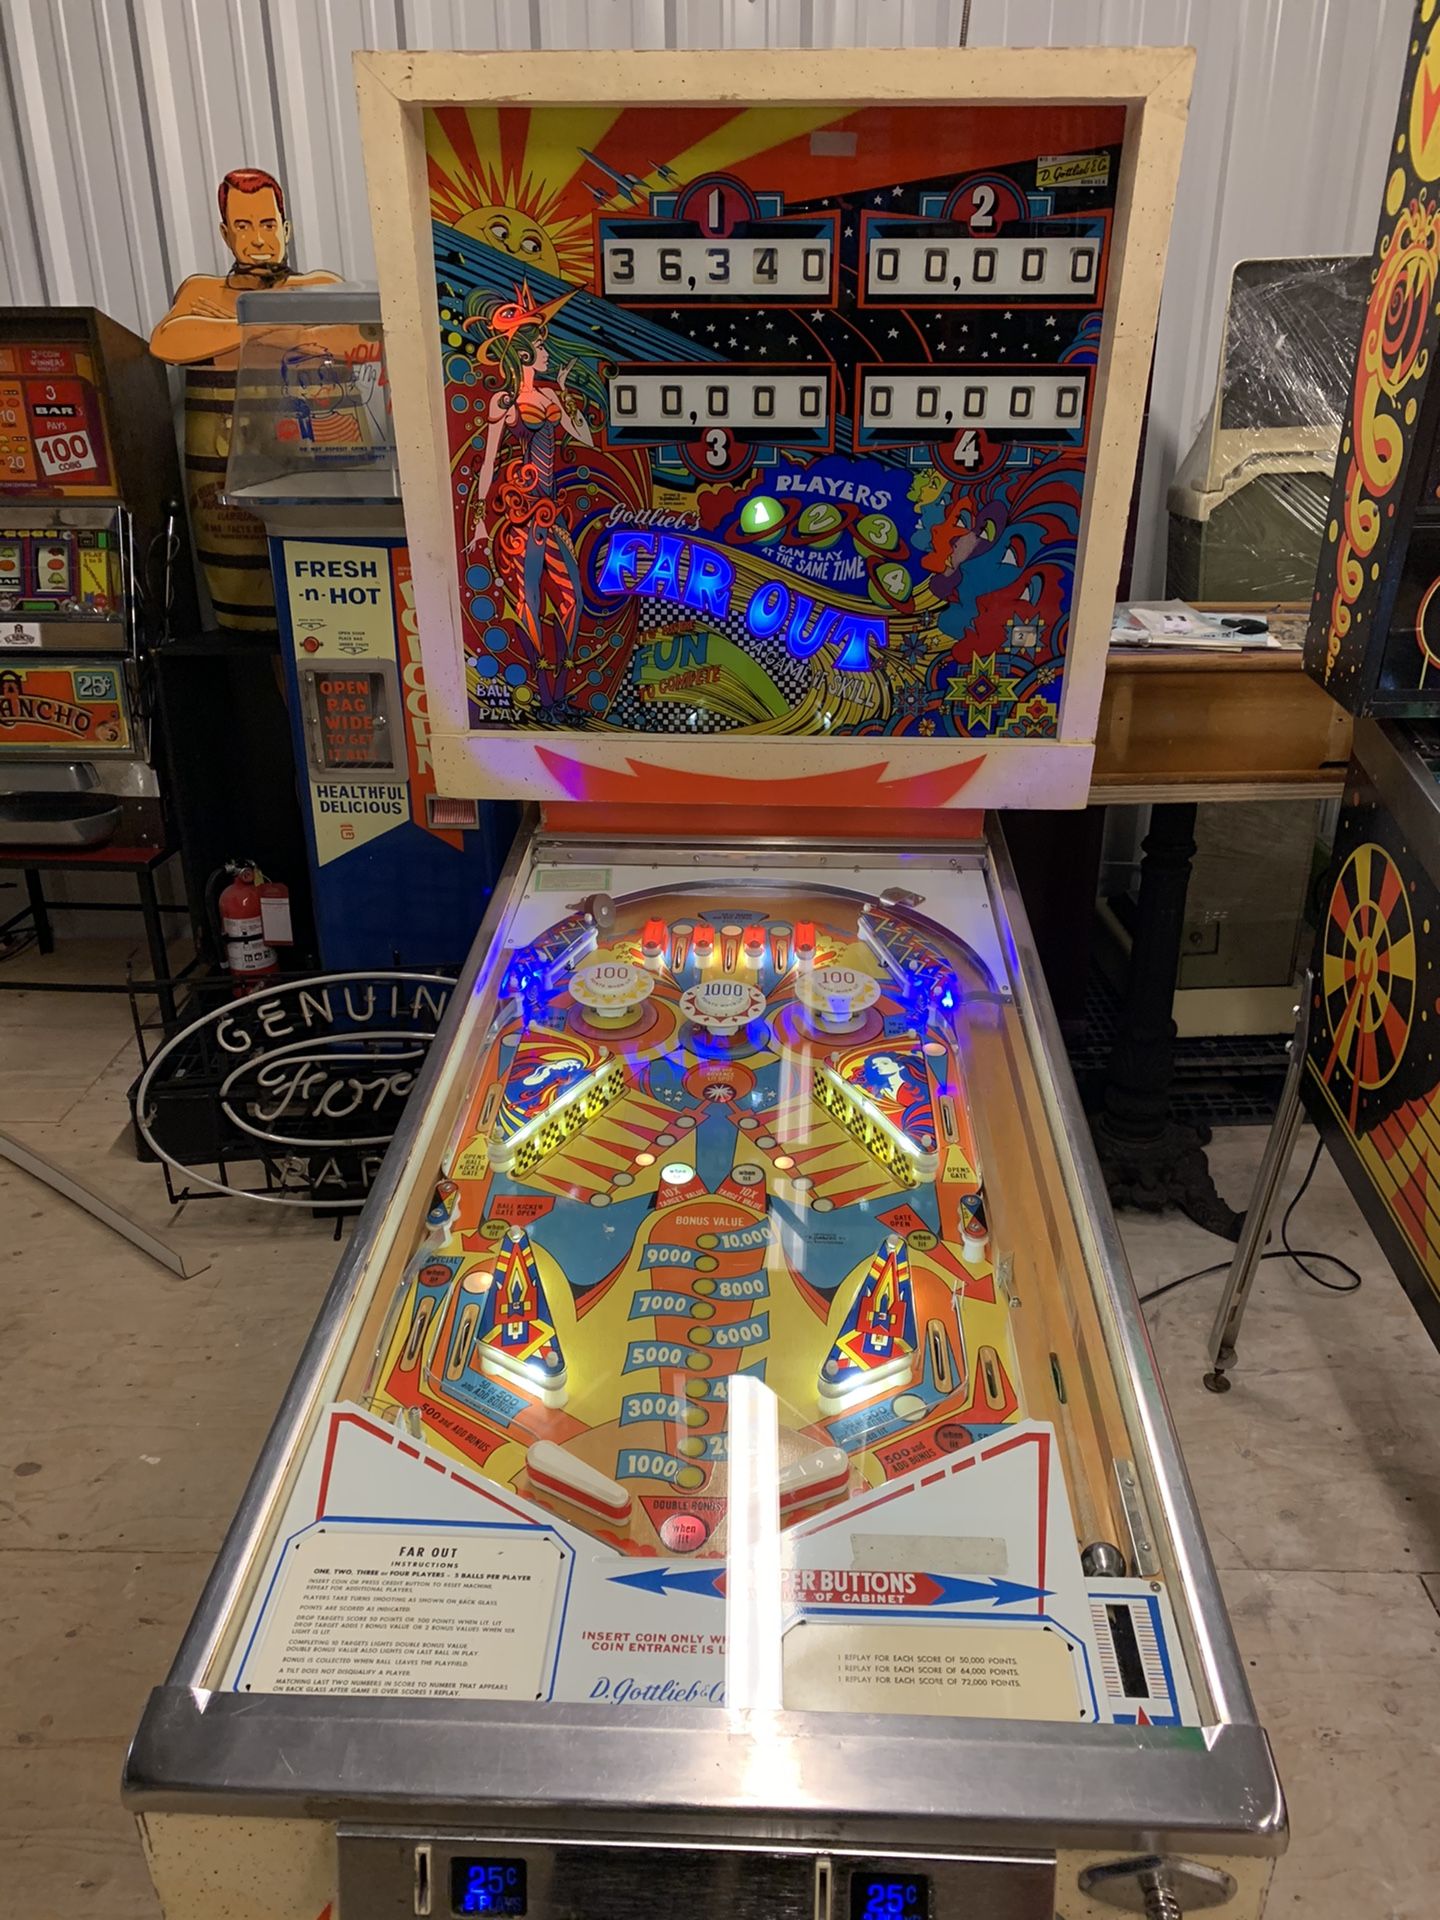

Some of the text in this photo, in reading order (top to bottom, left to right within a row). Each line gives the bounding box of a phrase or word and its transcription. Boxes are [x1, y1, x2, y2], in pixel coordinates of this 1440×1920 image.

[708, 188, 723, 232] 1
[970, 185, 997, 228] 2
[46, 385, 56, 400] 3
[35, 406, 74, 415] BAR
[47, 422, 67, 430] PAYS
[41, 434, 89, 464] 100
[706, 429, 729, 468] 3
[953, 430, 980, 468] 4
[7, 456, 25, 469] 20
[58, 461, 82, 471] COINS
[776, 475, 892, 510] PLAYERS
[605, 502, 700, 531] Gottlieb's
[753, 501, 770, 525] 1
[809, 503, 833, 531] 2
[869, 519, 892, 545] 3
[778, 545, 843, 561] CAN PLAY
[294, 561, 377, 578] FRESH
[762, 547, 866, 581] AT THE SAME TIME
[883, 569, 906, 594] 4
[330, 588, 381, 605] HOT
[598, 530, 889, 672] FAR OUT
[631, 631, 709, 684] FUN
[319, 680, 368, 695] OPEN
[659, 665, 721, 694] COMPETE
[766, 651, 811, 683] GAME
[829, 676, 876, 708] SKILL
[476, 684, 510, 697] BALL
[0, 698, 90, 732] ANCHO
[479, 708, 522, 720] PLAY
[325, 716, 373, 730] WIDE
[327, 734, 345, 745] TO
[317, 785, 405, 800] HEALTHFUL
[320, 800, 402, 815] DELICIOUS
[595, 967, 629, 979] 100
[822, 972, 856, 984] 100
[705, 984, 743, 997] 1000
[217, 985, 447, 1052] GENUIN
[662, 1186, 682, 1199] 10X
[739, 1186, 759, 1199] 10X
[675, 1216, 745, 1227] BONUS VALUE
[647, 1249, 691, 1264] 9000
[719, 1279, 764, 1297] 8000
[639, 1296, 686, 1313] 7000
[715, 1323, 763, 1345] 6000
[631, 1348, 682, 1365] 5000
[473, 1388, 489, 1400] ADD
[488, 1396, 514, 1414] BONUS
[627, 1399, 680, 1417] 3000
[421, 1403, 441, 1419] 500
[452, 1425, 466, 1438] ADD
[466, 1434, 491, 1453] BONUS
[884, 1442, 927, 1465] 500 and
[627, 1455, 678, 1477] 1000
[653, 1500, 687, 1511] DOUBLE
[673, 1524, 696, 1534] when
[678, 1534, 690, 1544] lit
[399, 1546, 458, 1558] FAR OUT
[391, 1561, 459, 1569] INSTRUCTIONS
[821, 1571, 918, 1594] BUTTONS
[815, 1592, 906, 1604] OF CABINET
[582, 1631, 704, 1644] INSERT COIN ONLY
[591, 1643, 624, 1652] COIN
[629, 1643, 697, 1654] ENTRANCE
[702, 1645, 714, 1655] IS
[844, 1654, 872, 1662] REPLAY
[875, 1654, 890, 1662] FOR
[893, 1655, 914, 1663] EACH
[960, 1657, 985, 1665] 50,000
[875, 1665, 890, 1673] FOR
[918, 1666, 942, 1674] SCORE
[960, 1668, 987, 1676] 64,000
